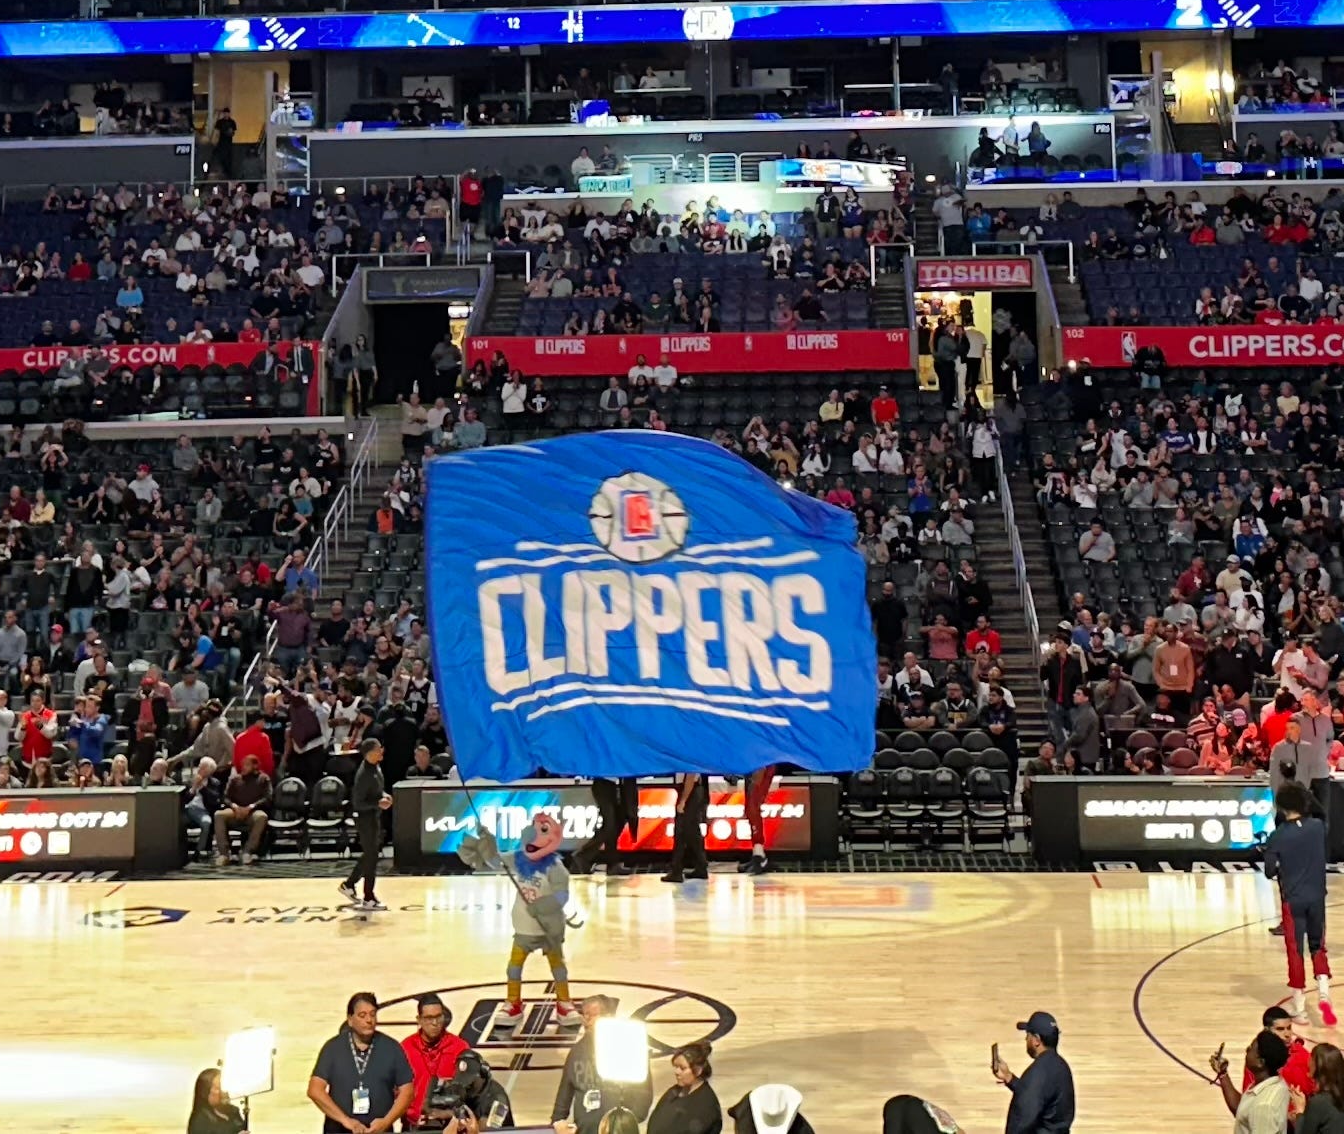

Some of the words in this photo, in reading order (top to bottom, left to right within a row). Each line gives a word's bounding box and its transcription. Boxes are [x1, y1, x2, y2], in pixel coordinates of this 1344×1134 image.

[507, 16, 521, 29] 12
[224, 19, 251, 48] 2
[920, 264, 1028, 284] TOSHIBA
[797, 333, 838, 350] CLIPPERS
[886, 332, 905, 342] 101
[1066, 329, 1085, 339] 102
[470, 339, 488, 350] 101
[546, 339, 586, 354] CLIPPERS
[671, 337, 711, 352] CLIPPERS
[22, 346, 177, 367] CLIPES.COM
[478, 570, 833, 696] CLIPPERS
[1145, 822, 1195, 839] ESPN
